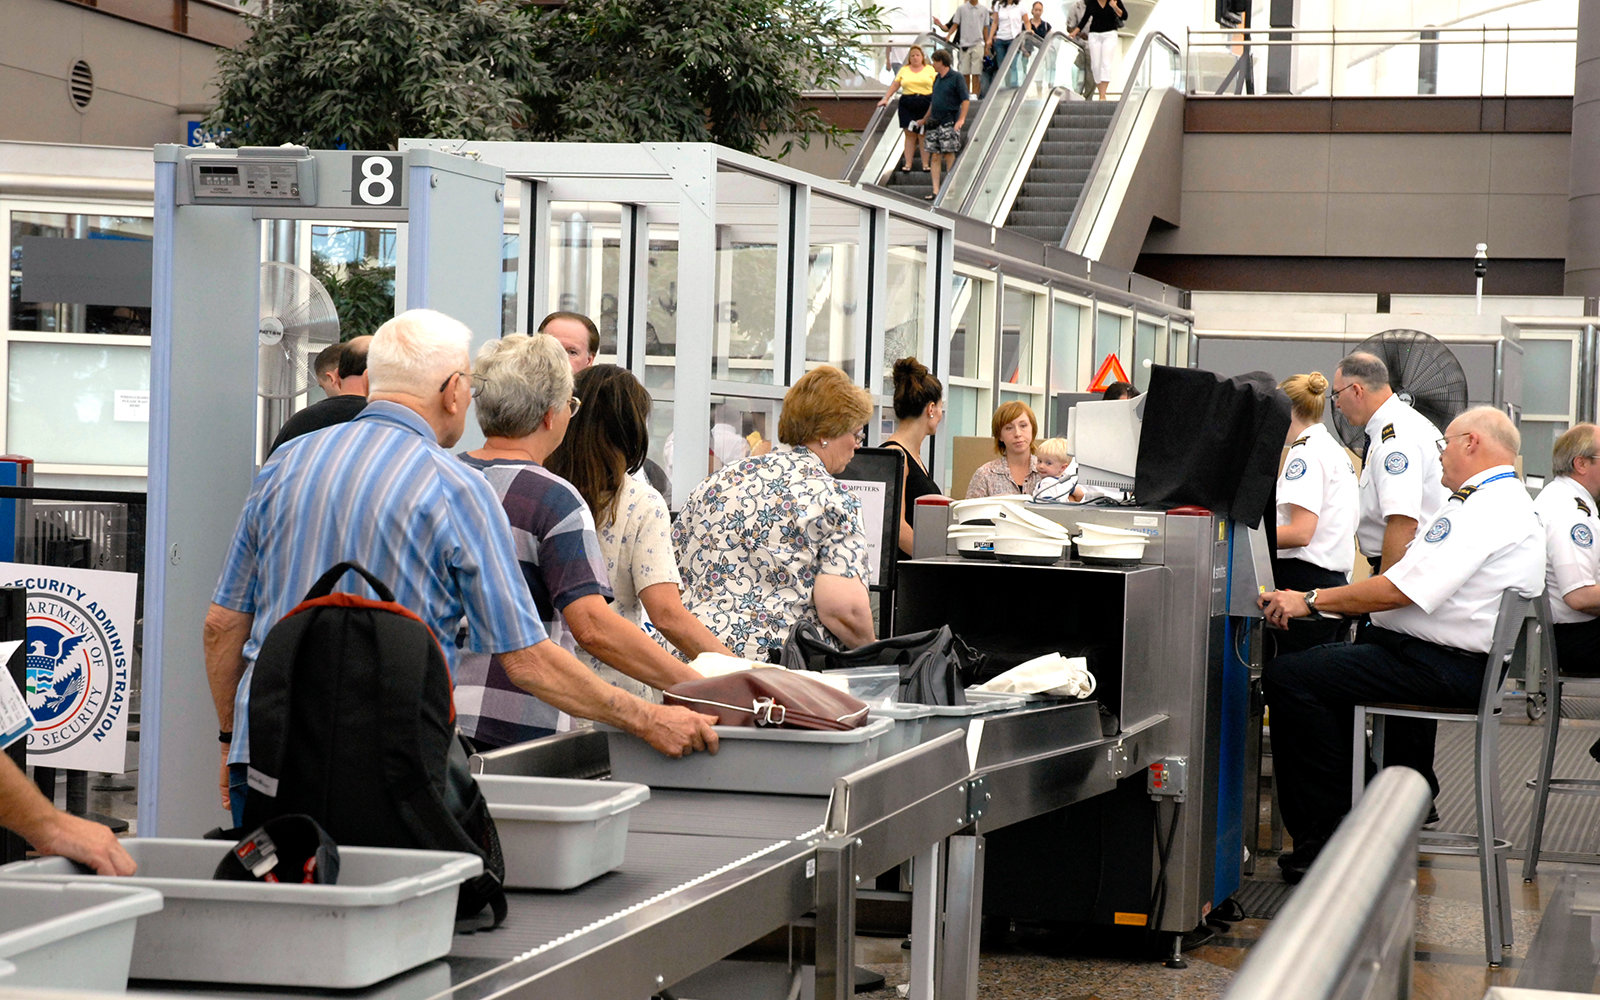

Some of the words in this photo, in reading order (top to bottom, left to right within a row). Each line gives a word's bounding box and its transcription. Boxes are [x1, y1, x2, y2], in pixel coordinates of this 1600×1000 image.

[359, 156, 394, 205] 8
[4, 578, 86, 601] ECURITY
[86, 601, 127, 743] ADMINISTRATION
[27, 601, 96, 644] ARTMENT
[90, 646, 104, 668] OF
[43, 686, 103, 746] SECURITY
